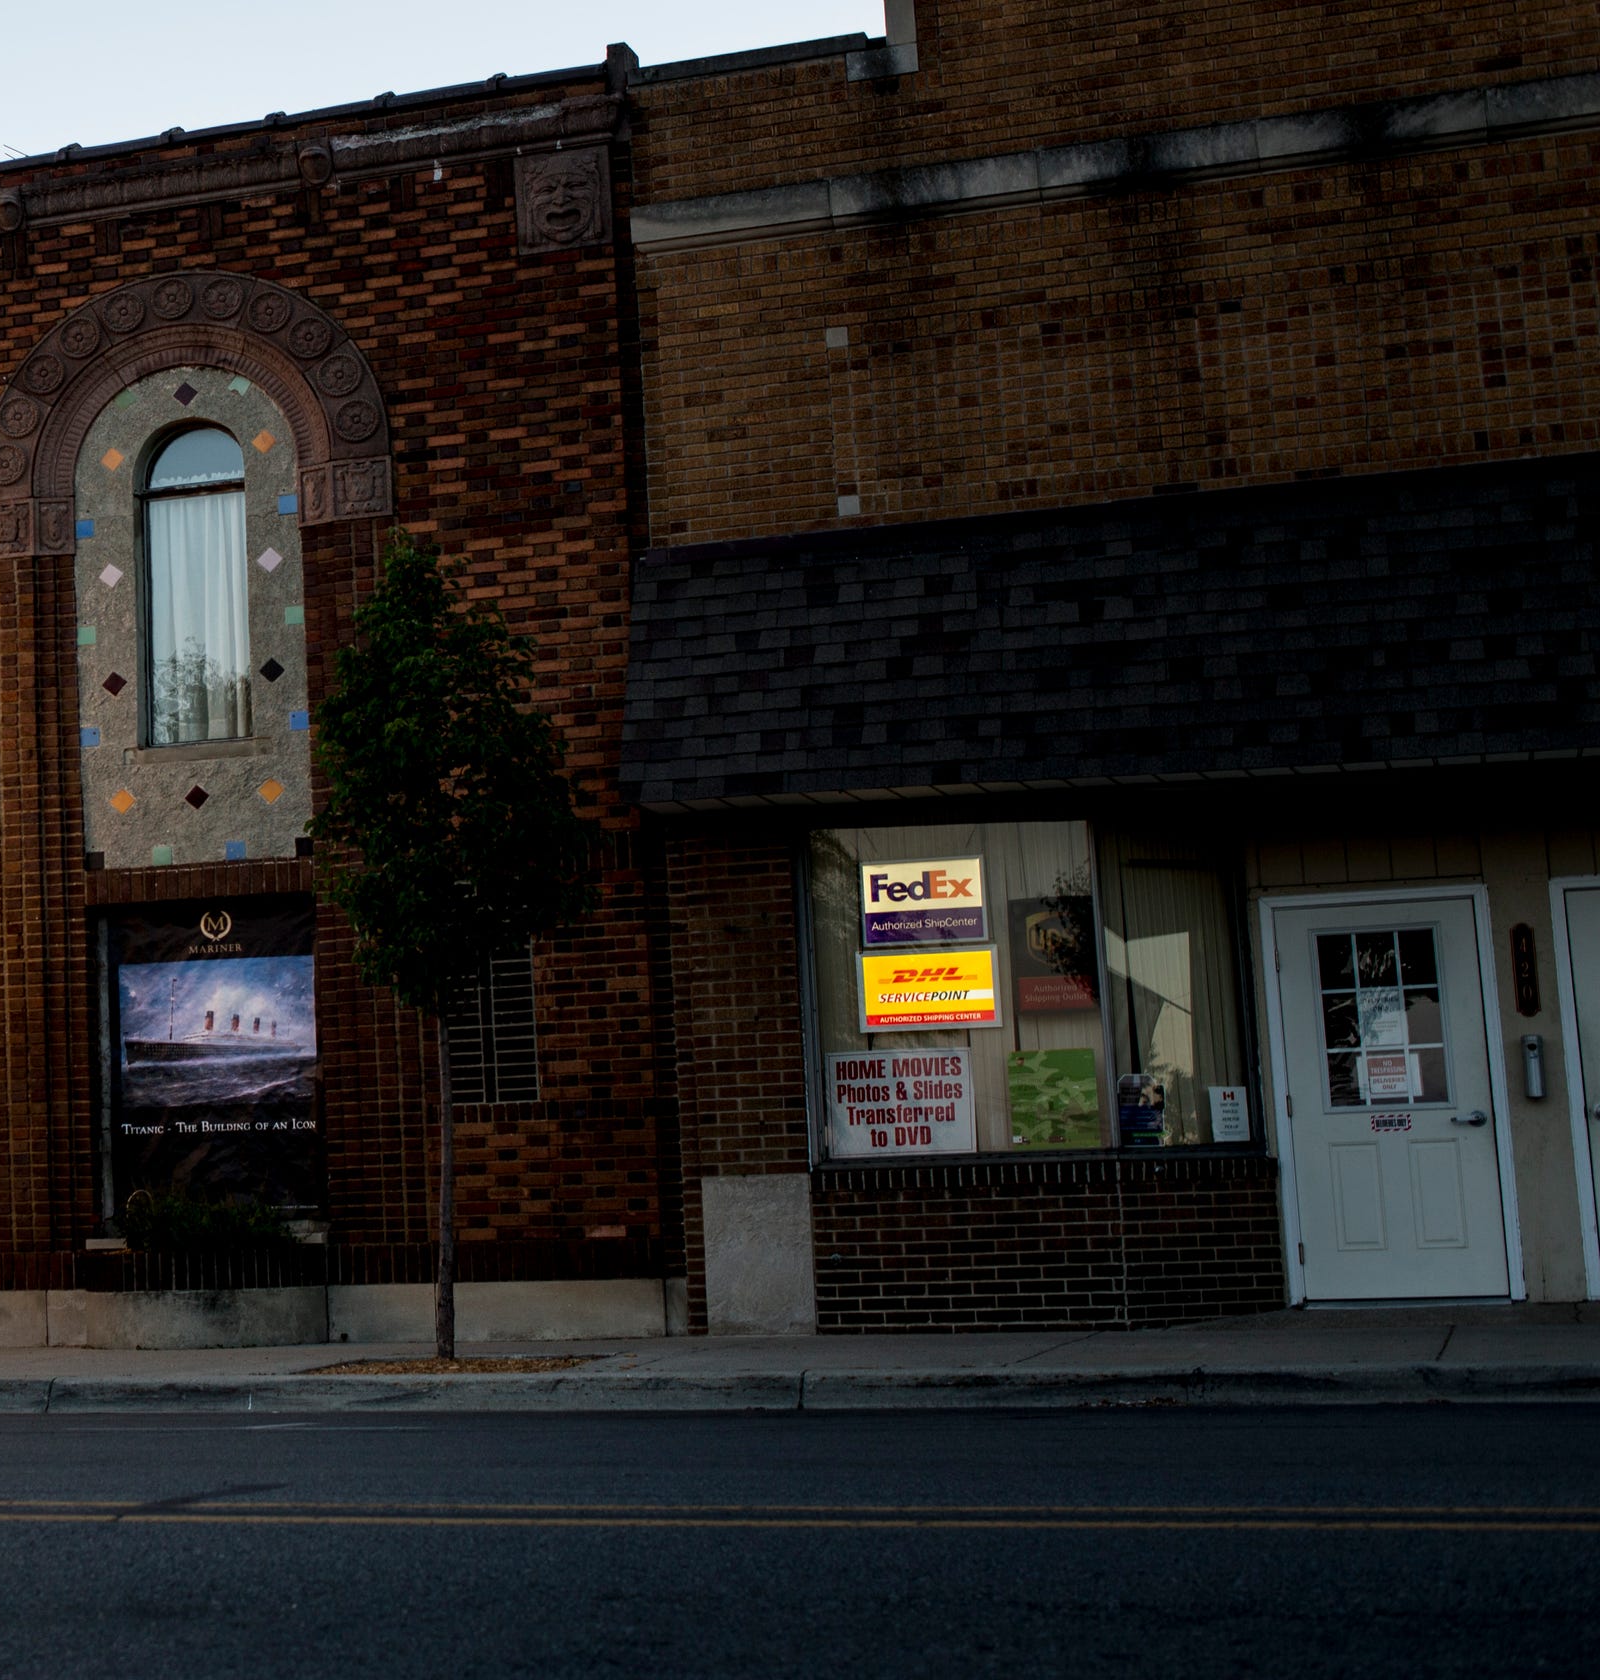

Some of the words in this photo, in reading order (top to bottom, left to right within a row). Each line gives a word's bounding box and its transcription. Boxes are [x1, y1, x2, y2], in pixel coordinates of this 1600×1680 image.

[869, 870, 974, 903] FedEx
[205, 916, 226, 932] M
[871, 920, 922, 931] Authorized
[924, 917, 978, 930] ShipCenter
[188, 943, 242, 955] MARINER
[891, 967, 965, 984] DHL
[879, 990, 970, 1004] SERVICEPOINT
[879, 1015, 922, 1024] AUTHORIZED
[923, 1014, 955, 1022] SHIPPING
[955, 1012, 981, 1021] CENTER
[835, 1059, 886, 1081] HOME
[892, 1056, 962, 1078] MOVIES
[837, 1083, 890, 1104] Photos
[896, 1081, 908, 1101] &
[913, 1080, 963, 1100] Slides
[846, 1102, 956, 1126] Transferred
[120, 1122, 165, 1135] TITANIC
[175, 1120, 198, 1133] THE
[201, 1119, 252, 1133] BUILDING
[255, 1121, 269, 1130] OF
[272, 1120, 288, 1130] AN
[291, 1118, 317, 1130] ICON
[870, 1129, 888, 1148] to
[894, 1126, 932, 1147] DVD
